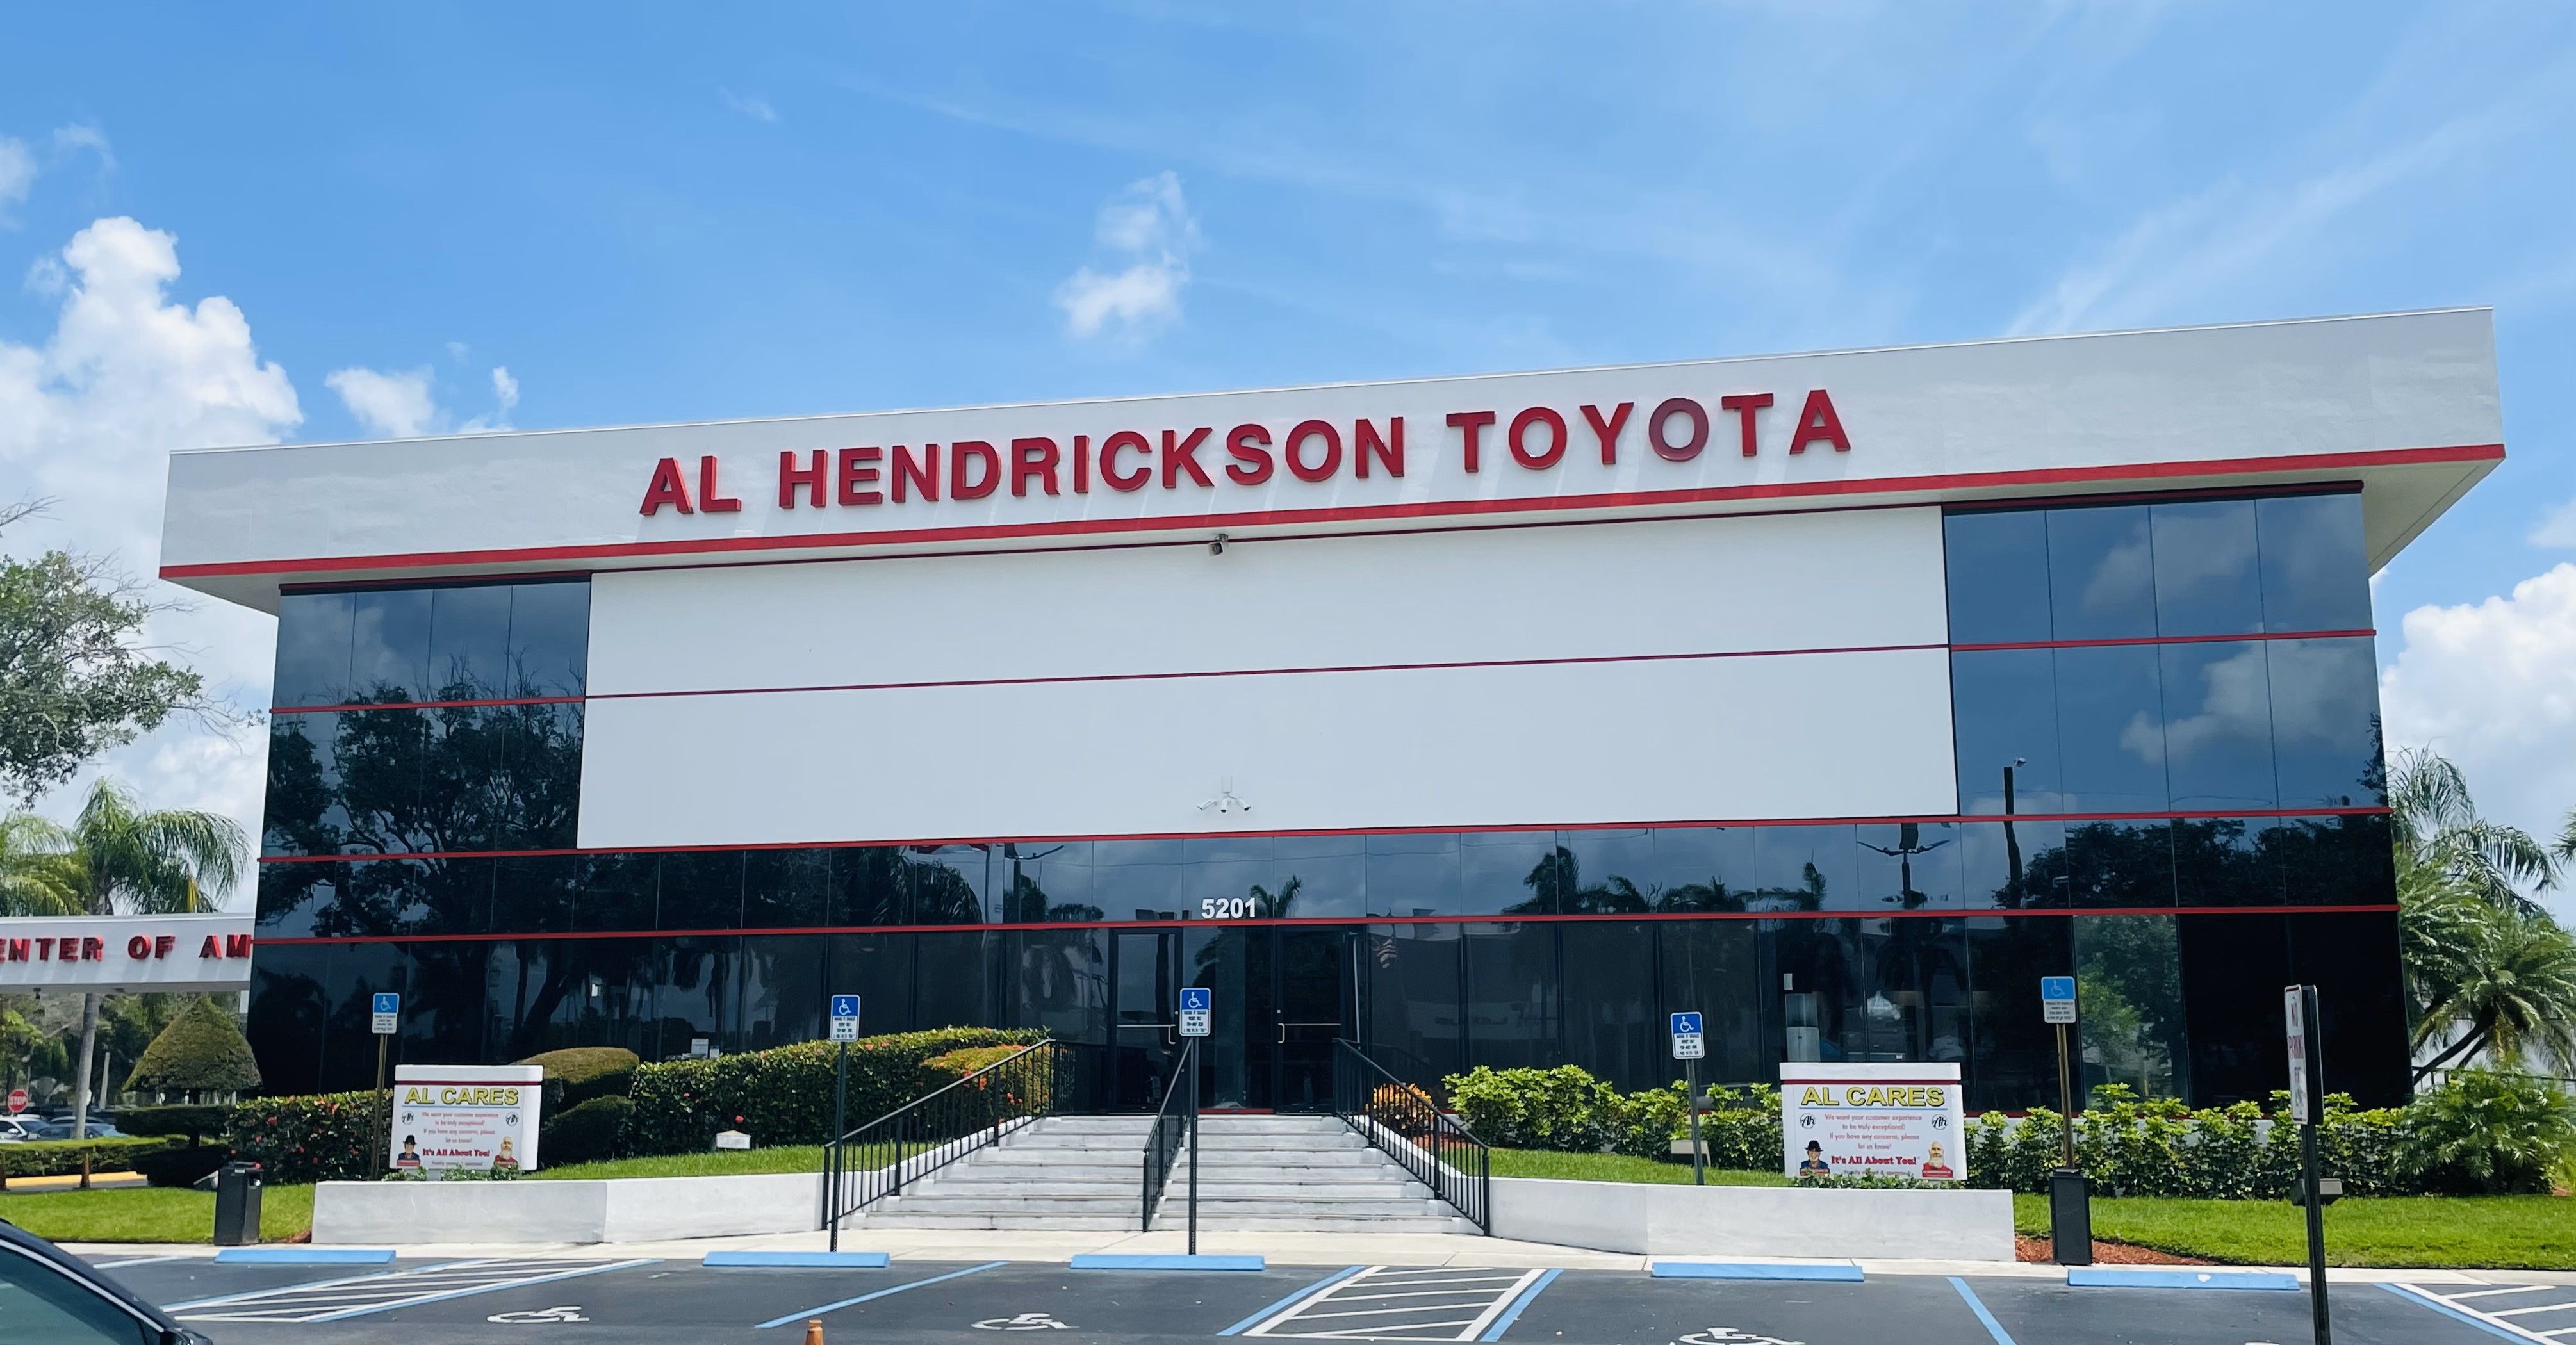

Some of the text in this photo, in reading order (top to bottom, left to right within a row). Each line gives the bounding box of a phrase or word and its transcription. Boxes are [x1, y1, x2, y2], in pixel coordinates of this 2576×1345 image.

[639, 389, 1851, 516] AL HENDRICKSON TOYOTA
[1201, 897, 1256, 919] 5201
[127, 935, 176, 959] OF
[9, 1096, 27, 1105] STOP
[405, 1087, 519, 1105] AL CARES
[1801, 1086, 1945, 1107] AL CARES
[449, 1148, 472, 1157] About
[1848, 1155, 1862, 1164] All
[1864, 1155, 1894, 1164] About
[1895, 1156, 1917, 1165] You!
